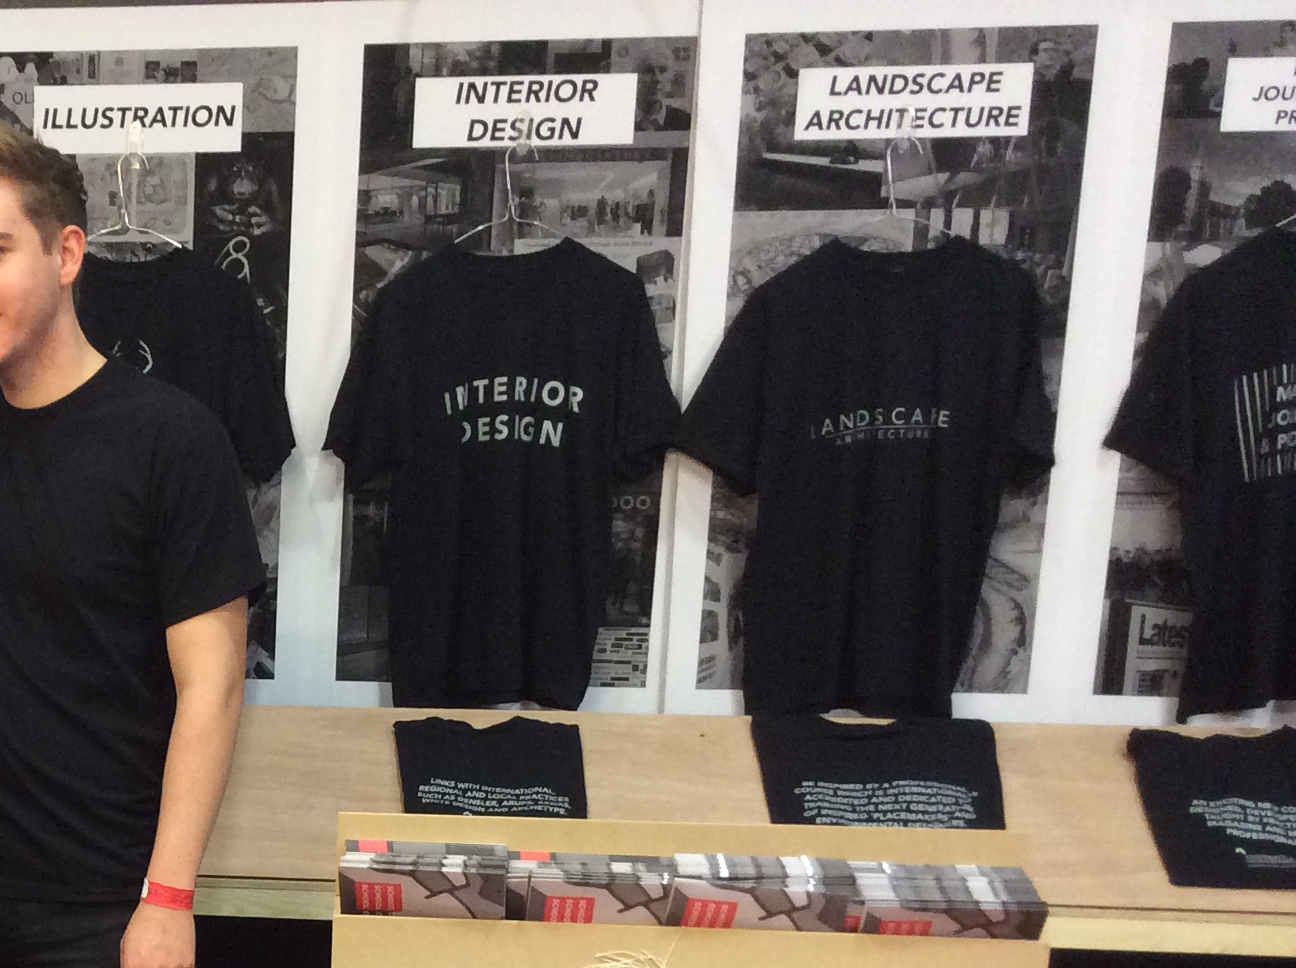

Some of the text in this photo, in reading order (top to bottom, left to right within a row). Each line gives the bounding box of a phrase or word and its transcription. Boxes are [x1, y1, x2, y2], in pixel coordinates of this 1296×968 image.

[455, 79, 599, 105] INTERIOR
[828, 71, 1004, 97] LANDSCAPE
[42, 105, 236, 129] ILLUSTRATION
[803, 105, 1022, 131] ARCHITECTURE
[466, 117, 582, 142] DESIGN
[444, 376, 583, 415] INTERIOR
[430, 778, 455, 787] LINKS
[794, 787, 834, 795] COURSE
[418, 785, 463, 796] REGIONAL
[519, 793, 569, 802] PRACTICES
[804, 794, 868, 805] ACCREDITED
[898, 795, 956, 804] DEDICATED
[855, 804, 875, 812] THE
[878, 803, 908, 811] NEXT
[954, 811, 976, 819] AND
